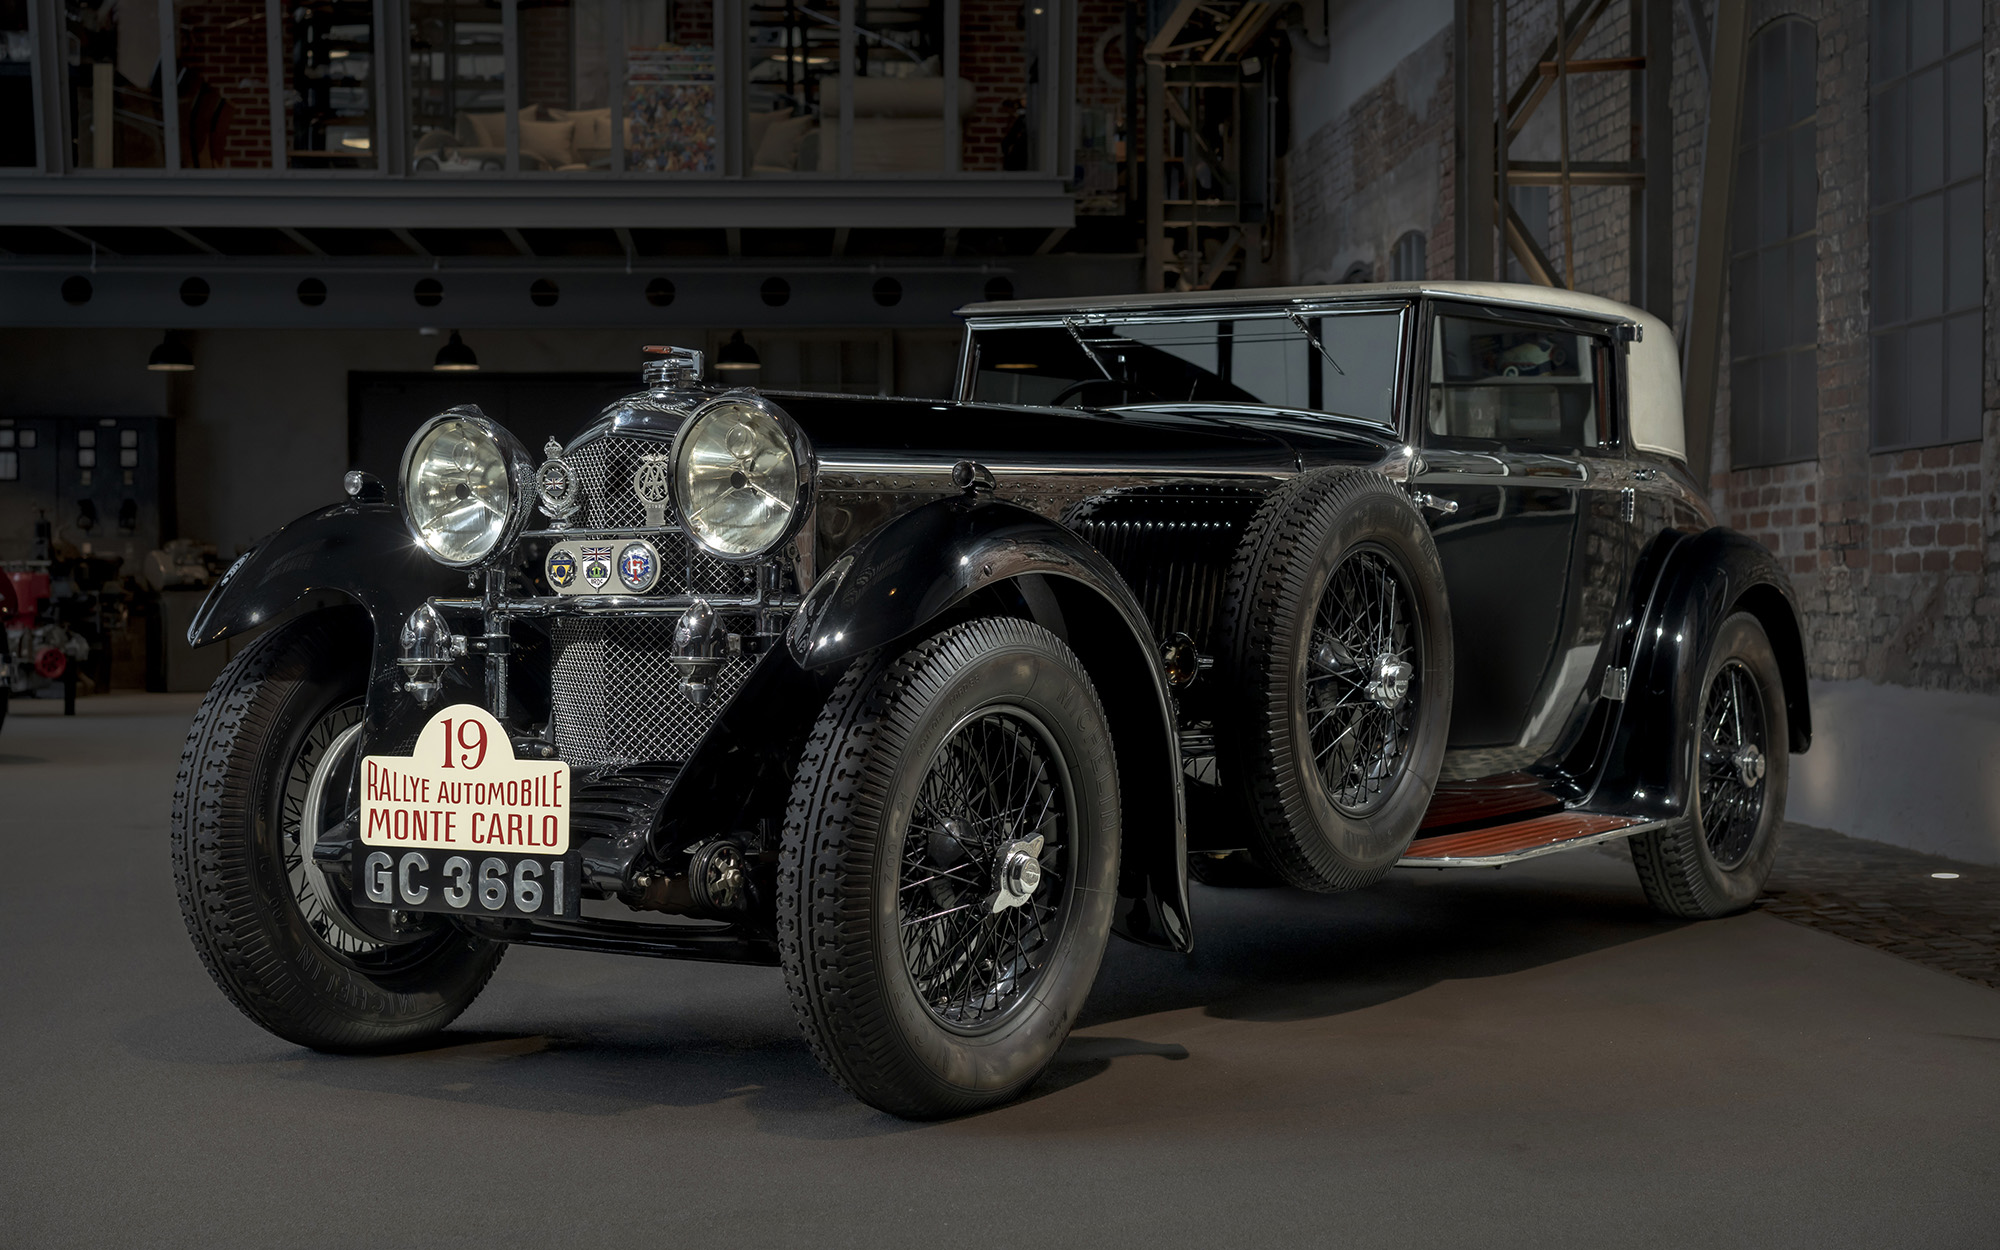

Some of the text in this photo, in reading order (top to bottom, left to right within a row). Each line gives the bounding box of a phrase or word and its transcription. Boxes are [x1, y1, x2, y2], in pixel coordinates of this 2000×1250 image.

[440, 718, 488, 770] 19
[1056, 678, 1117, 832] MICHELIN
[367, 760, 562, 808] RALLYE AUTOMOBILE
[367, 808, 558, 847] MONTE CARLO
[364, 851, 565, 915] GC 3661
[296, 943, 417, 1016] MICHELIN
